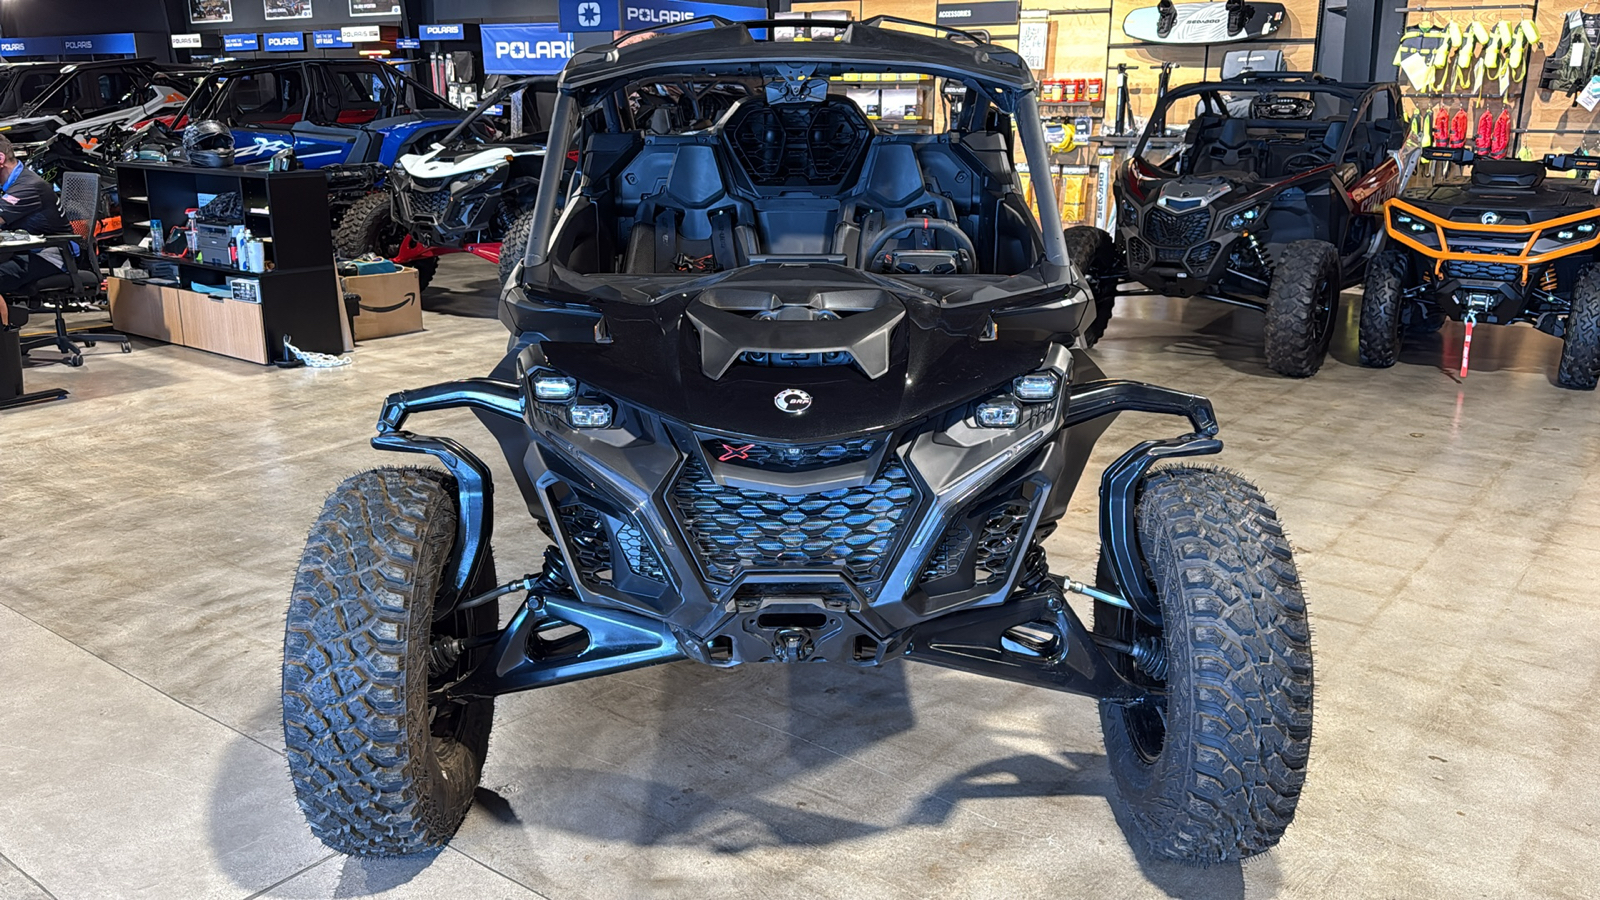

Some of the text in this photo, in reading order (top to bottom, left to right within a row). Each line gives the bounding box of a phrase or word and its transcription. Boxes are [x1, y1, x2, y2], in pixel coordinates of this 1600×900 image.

[627, 7, 694, 22] POLARIS
[938, 9, 972, 18] ACCESSORIES
[426, 26, 459, 34] POLARIS
[65, 41, 92, 49] POLARIS
[268, 37, 299, 46] POLARIS
[1, 43, 25, 51] POLARIS
